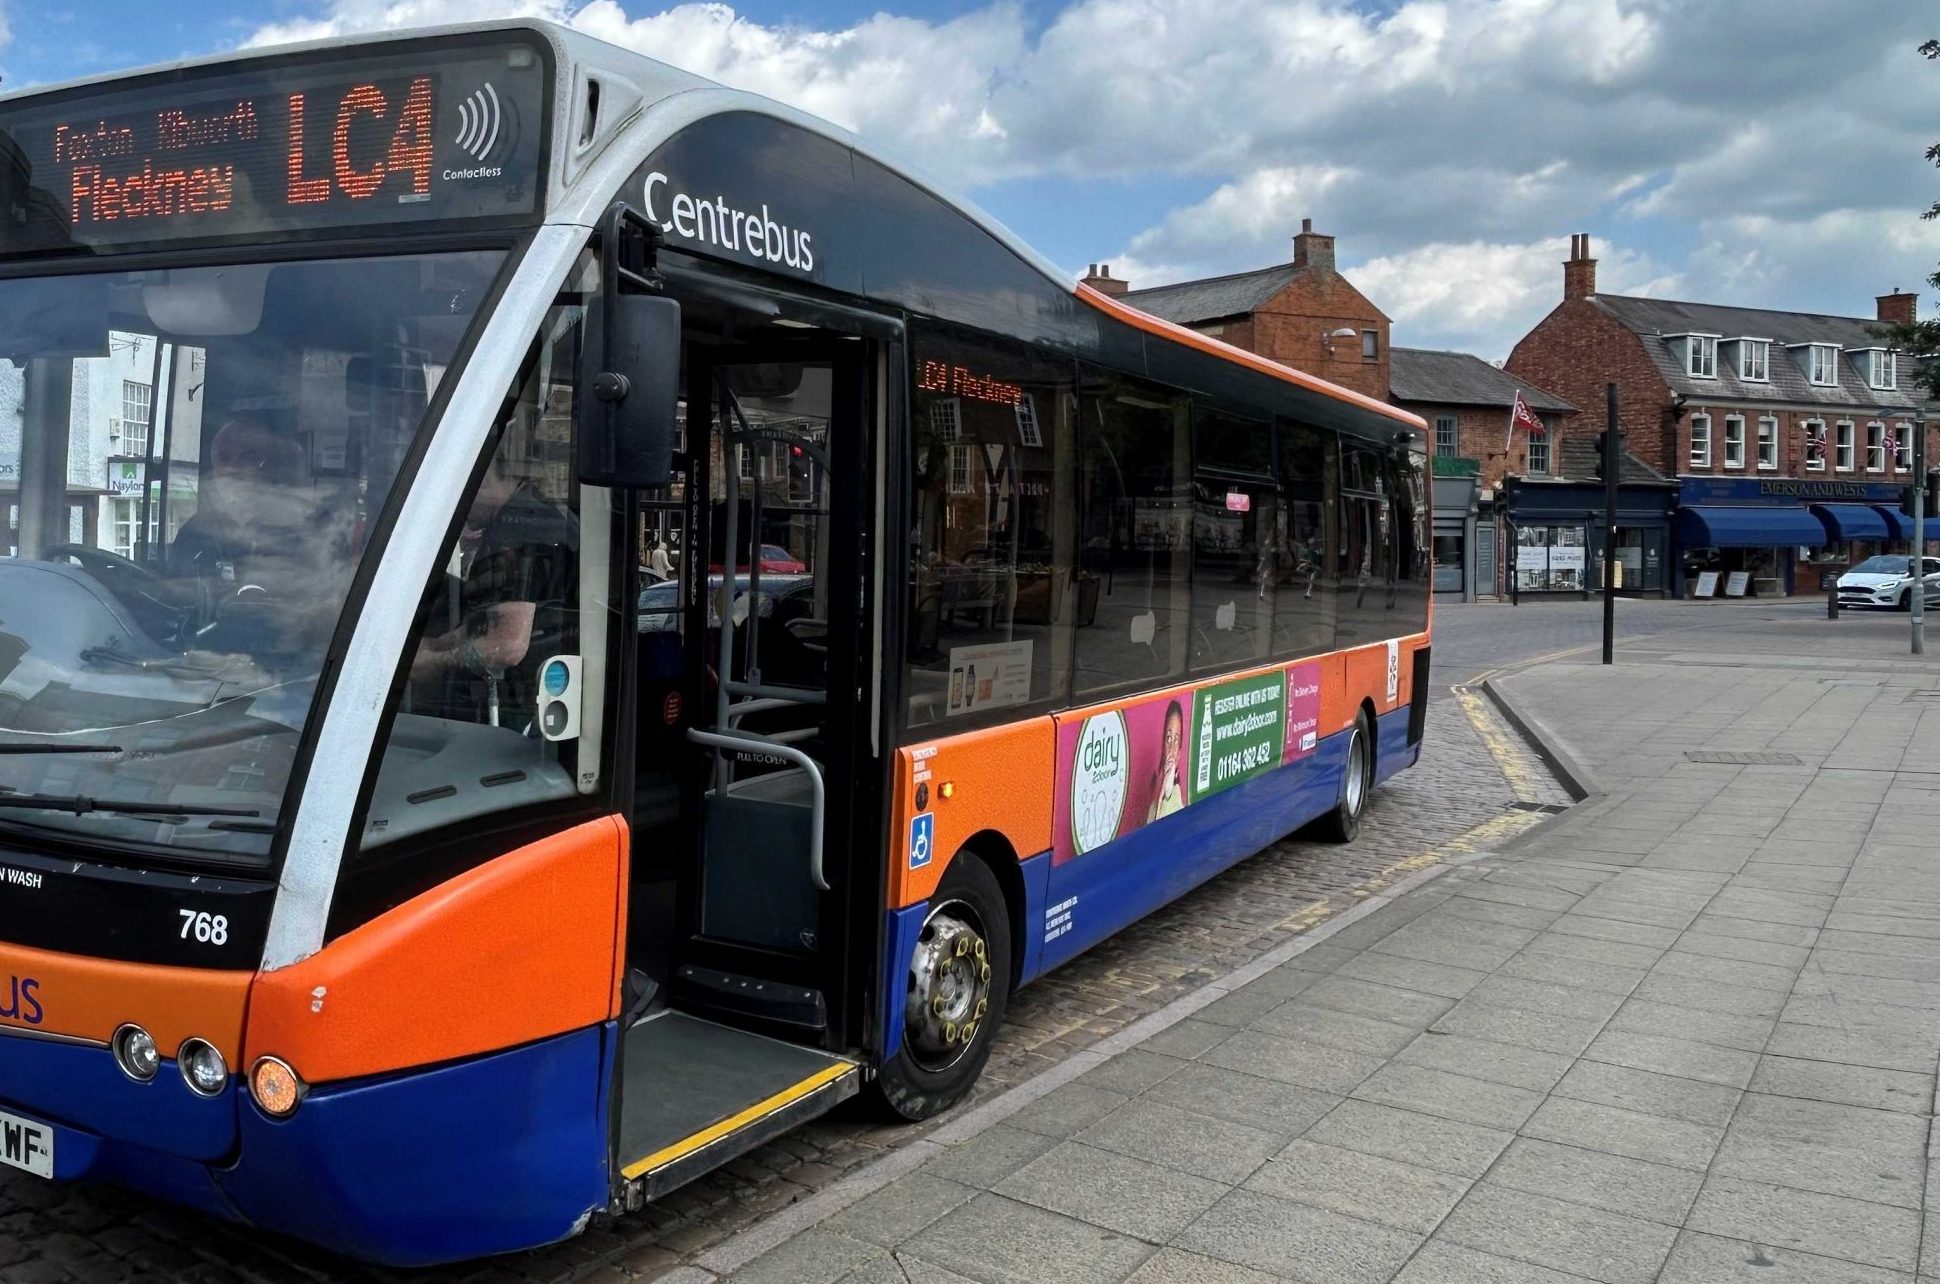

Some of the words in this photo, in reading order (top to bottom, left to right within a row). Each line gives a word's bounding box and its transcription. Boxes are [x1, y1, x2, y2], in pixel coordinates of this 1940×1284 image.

[287, 77, 433, 203] LC4
[72, 158, 233, 222] Fleckney
[443, 166, 502, 181] Contactless
[643, 171, 814, 273] Centrebus
[1760, 481, 1809, 497] EMERSON
[1810, 482, 1834, 497] AND
[1085, 726, 1120, 777] dairy
[1218, 752, 1242, 781] 01164
[8, 868, 42, 889] WASH
[179, 909, 228, 945] 768
[0, 1120, 42, 1165] WF
